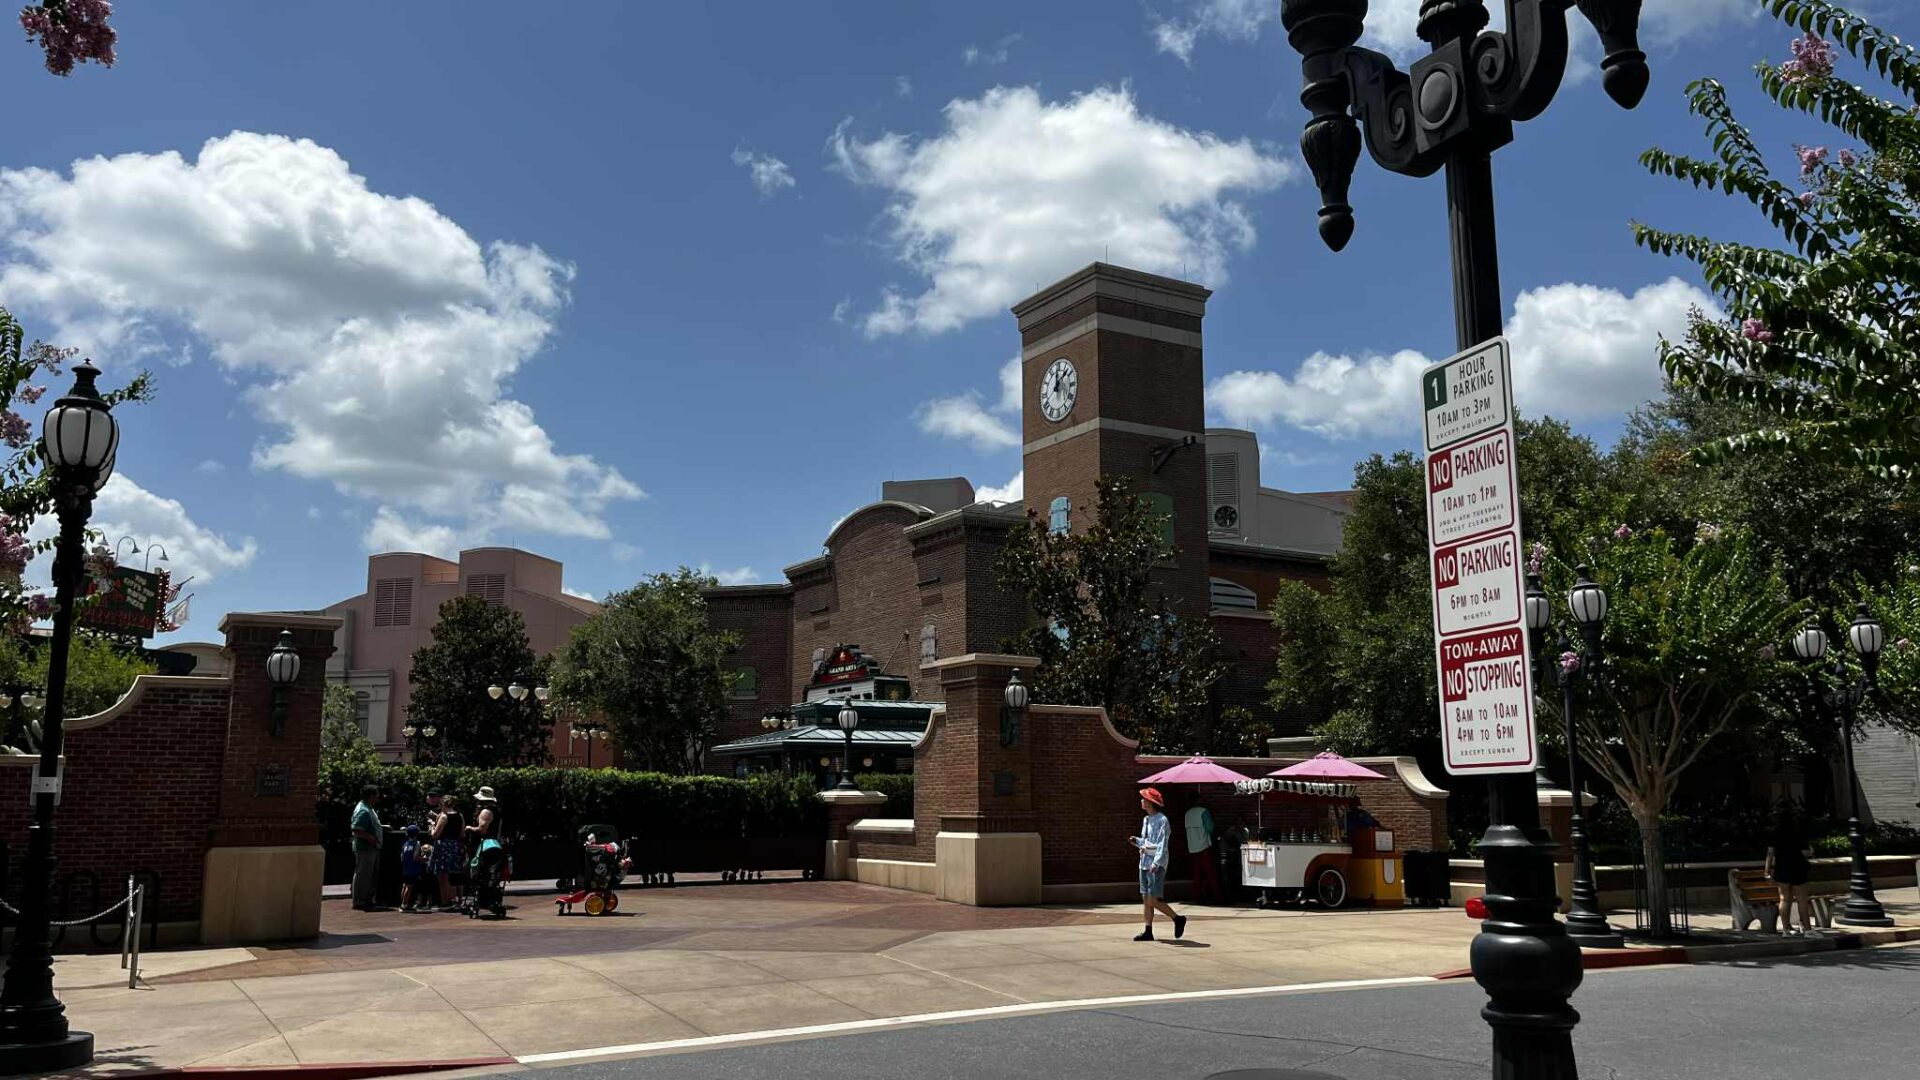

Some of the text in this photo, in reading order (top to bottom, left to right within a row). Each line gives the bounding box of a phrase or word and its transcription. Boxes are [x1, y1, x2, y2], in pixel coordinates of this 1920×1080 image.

[1459, 356, 1486, 380] HOUR
[1431, 377, 1439, 402] 1
[1453, 369, 1494, 400] PARKING
[1437, 397, 1491, 428] 10AM TO 3PM
[1436, 414, 1496, 440] EXCEPT HOLIDAYS
[1432, 439, 1505, 487] NO PARKING
[1442, 485, 1497, 513] 10AM TO 1PM
[1473, 503, 1504, 517] TUESDAYS
[1442, 514, 1502, 535] STREET CLEANING
[1438, 541, 1512, 583] NO PARKING
[1450, 587, 1501, 610] 6PM TO 8AM
[1463, 610, 1492, 621] NIGHTLY
[1445, 634, 1519, 660] TOW-AWAY
[1446, 660, 1522, 696] NO STOPPING
[1456, 702, 1519, 723] 8AM TO 10AM
[1457, 723, 1514, 742] 4PM TO 6PM
[1460, 747, 1515, 756] EXCEPT SUNDAY
